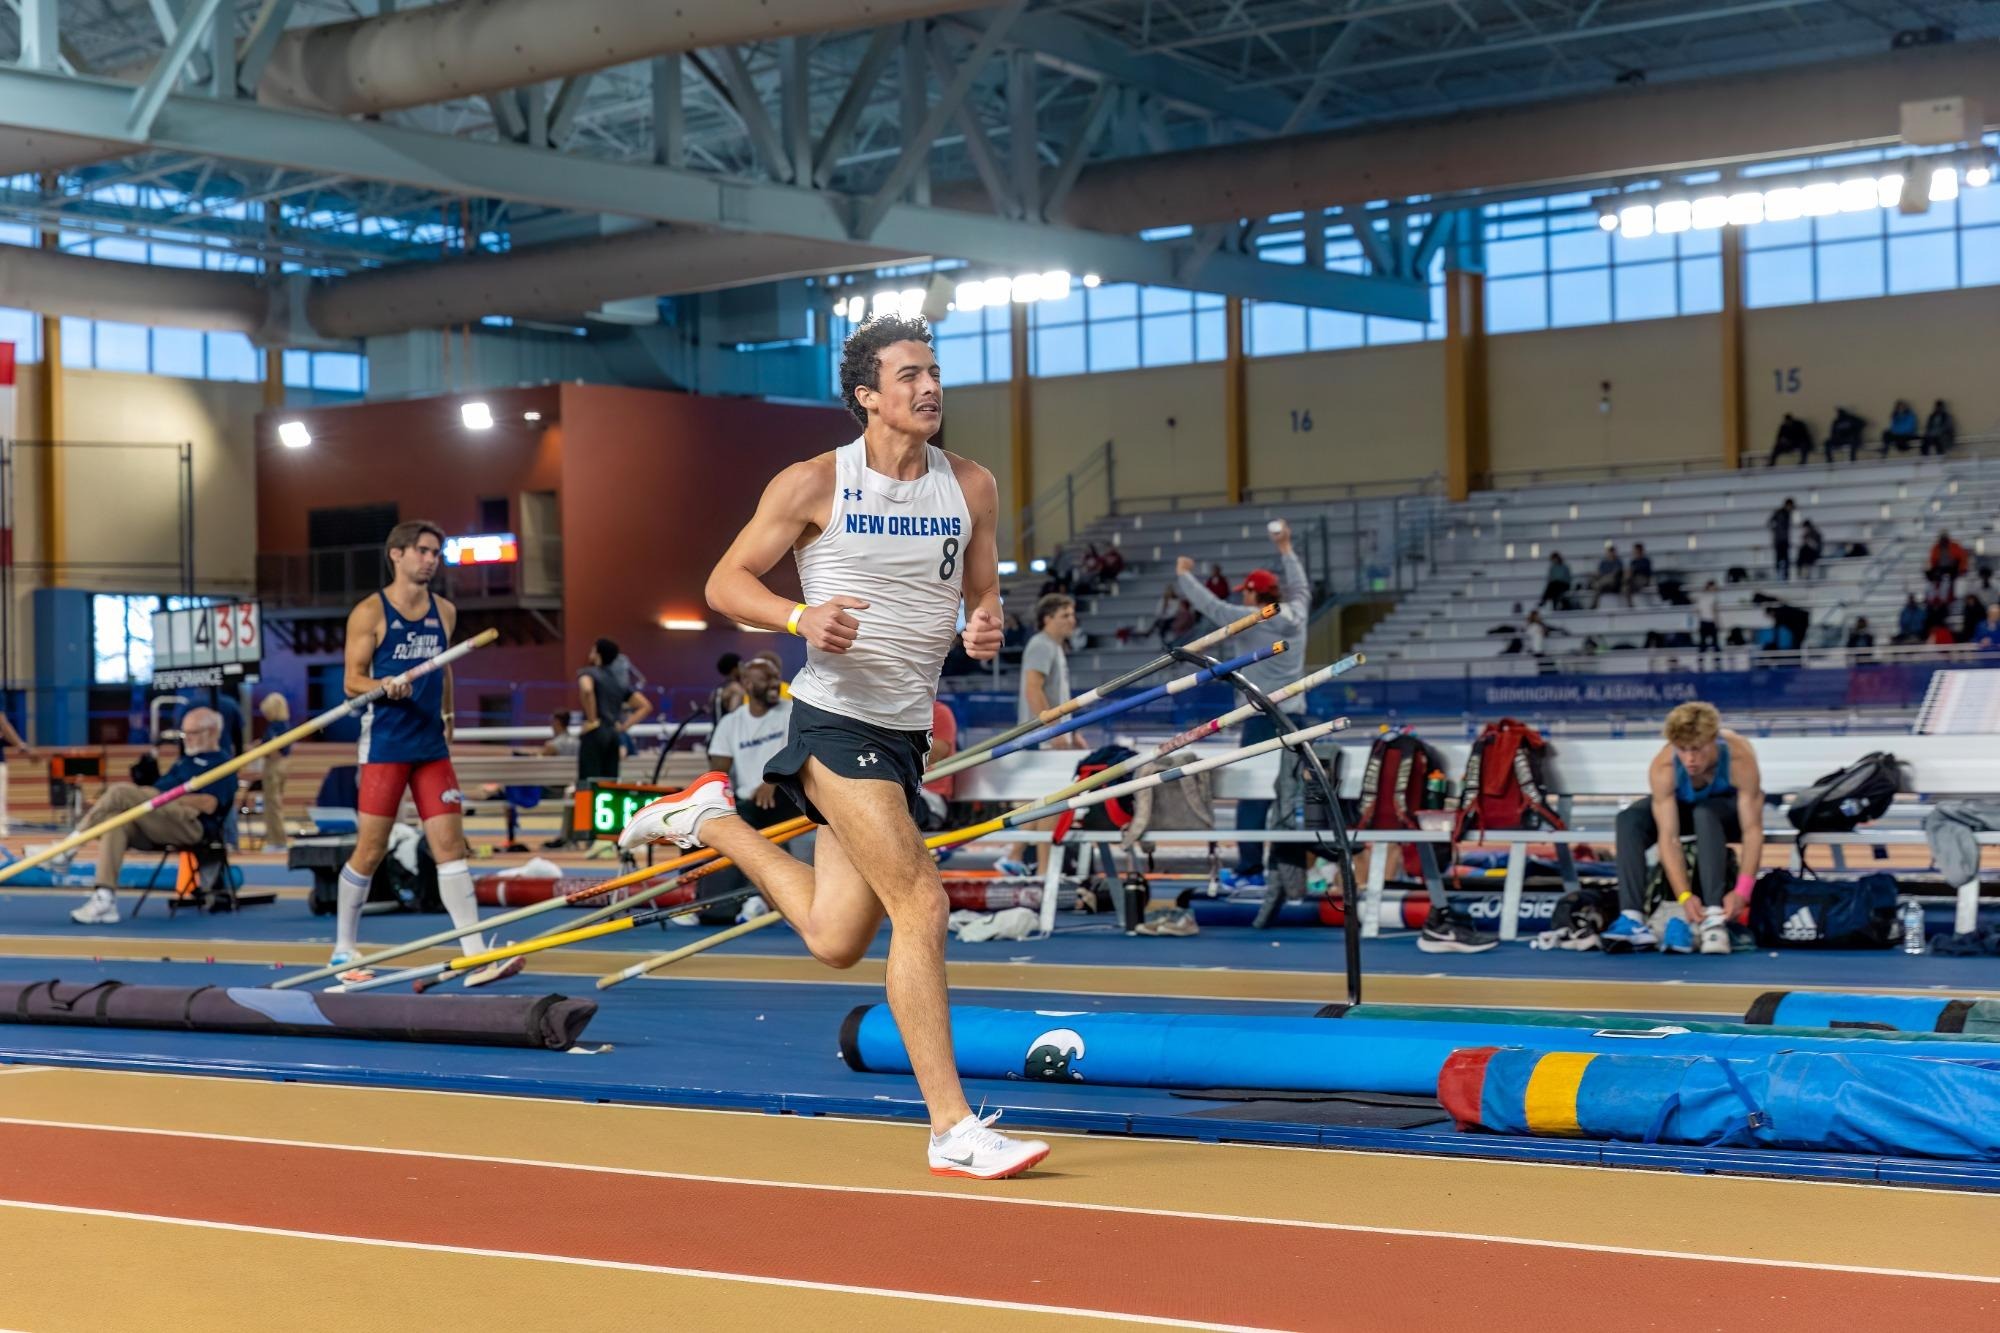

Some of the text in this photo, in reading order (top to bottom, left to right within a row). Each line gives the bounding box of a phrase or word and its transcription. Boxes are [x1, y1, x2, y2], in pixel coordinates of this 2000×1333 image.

[1773, 367, 1802, 394] 15
[1291, 409, 1313, 433] 16
[846, 513, 961, 537] NEW ORLEANS
[939, 537, 959, 581] 8
